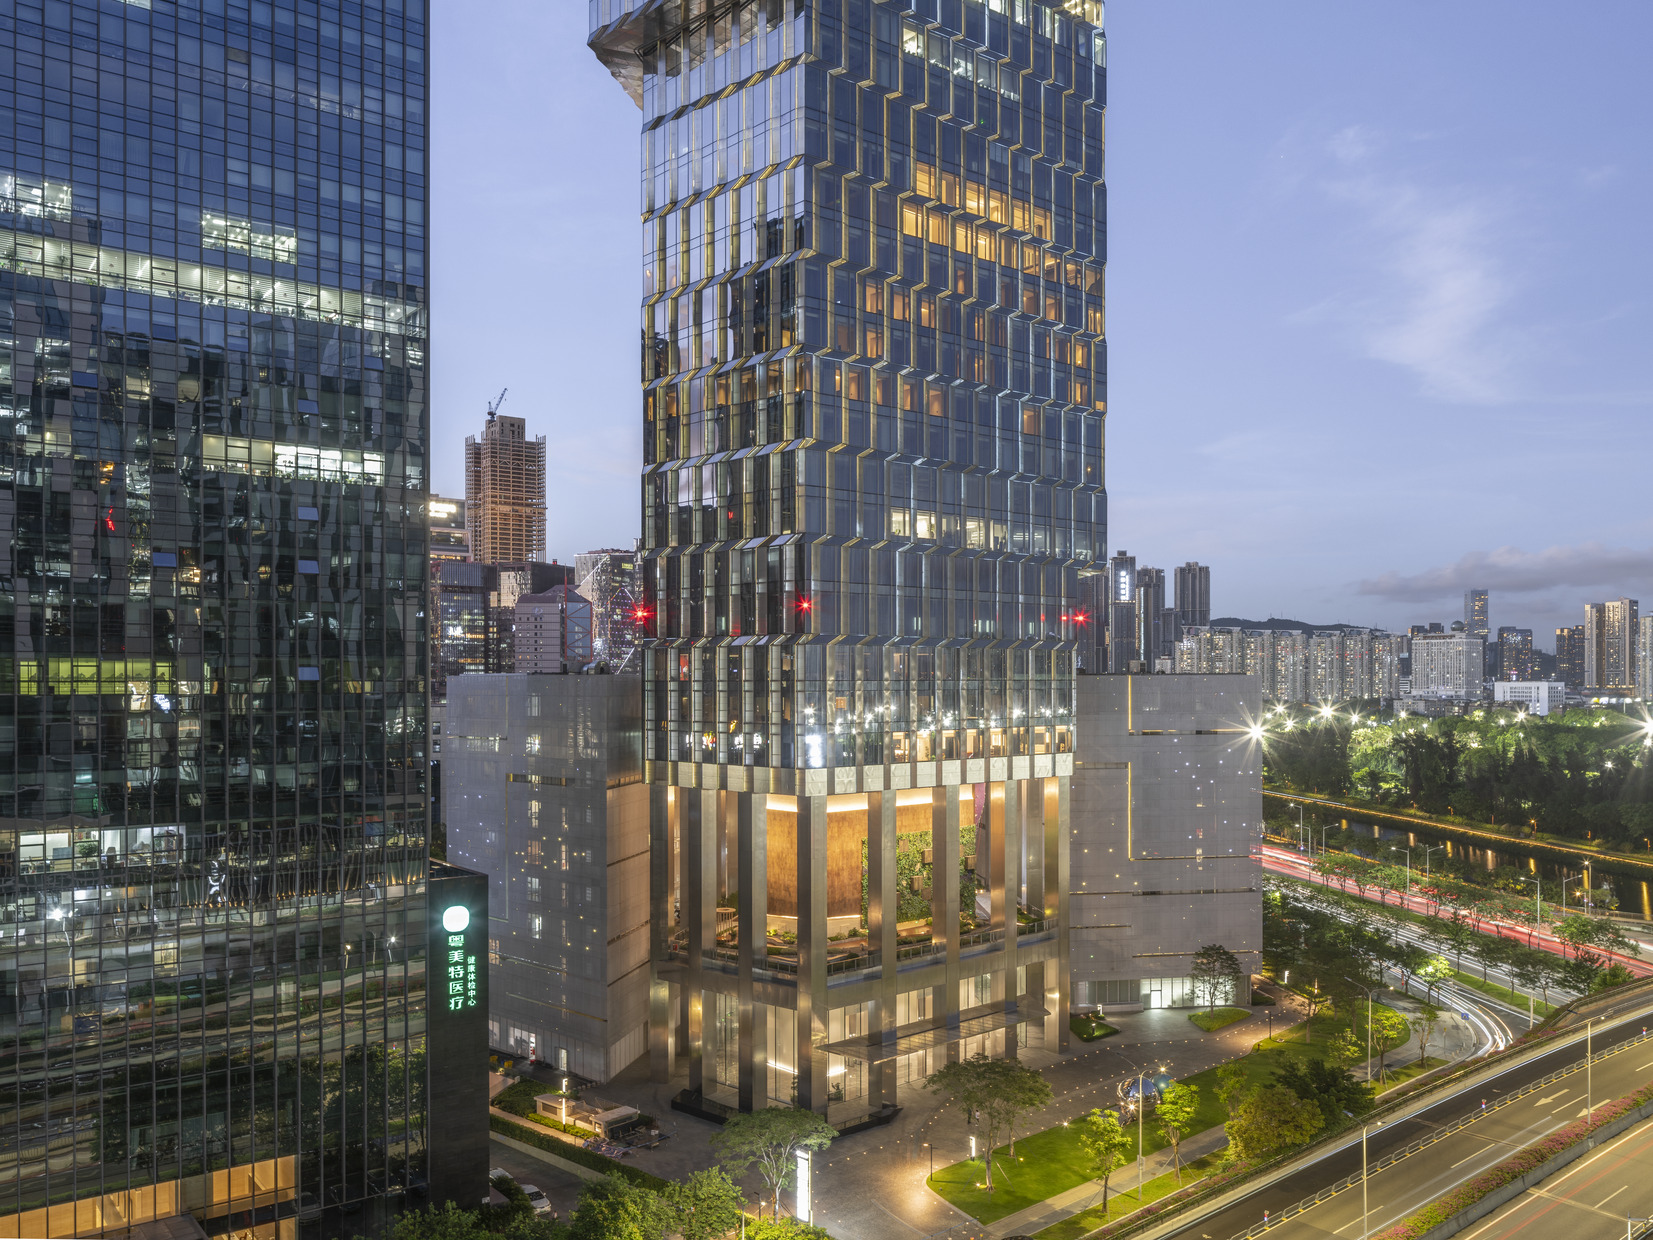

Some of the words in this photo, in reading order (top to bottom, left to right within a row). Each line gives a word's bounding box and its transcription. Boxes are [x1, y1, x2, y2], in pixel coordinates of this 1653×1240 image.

[448, 934, 465, 1011] 粤美特医疗
[467, 955, 476, 1007] 健康体检中心
